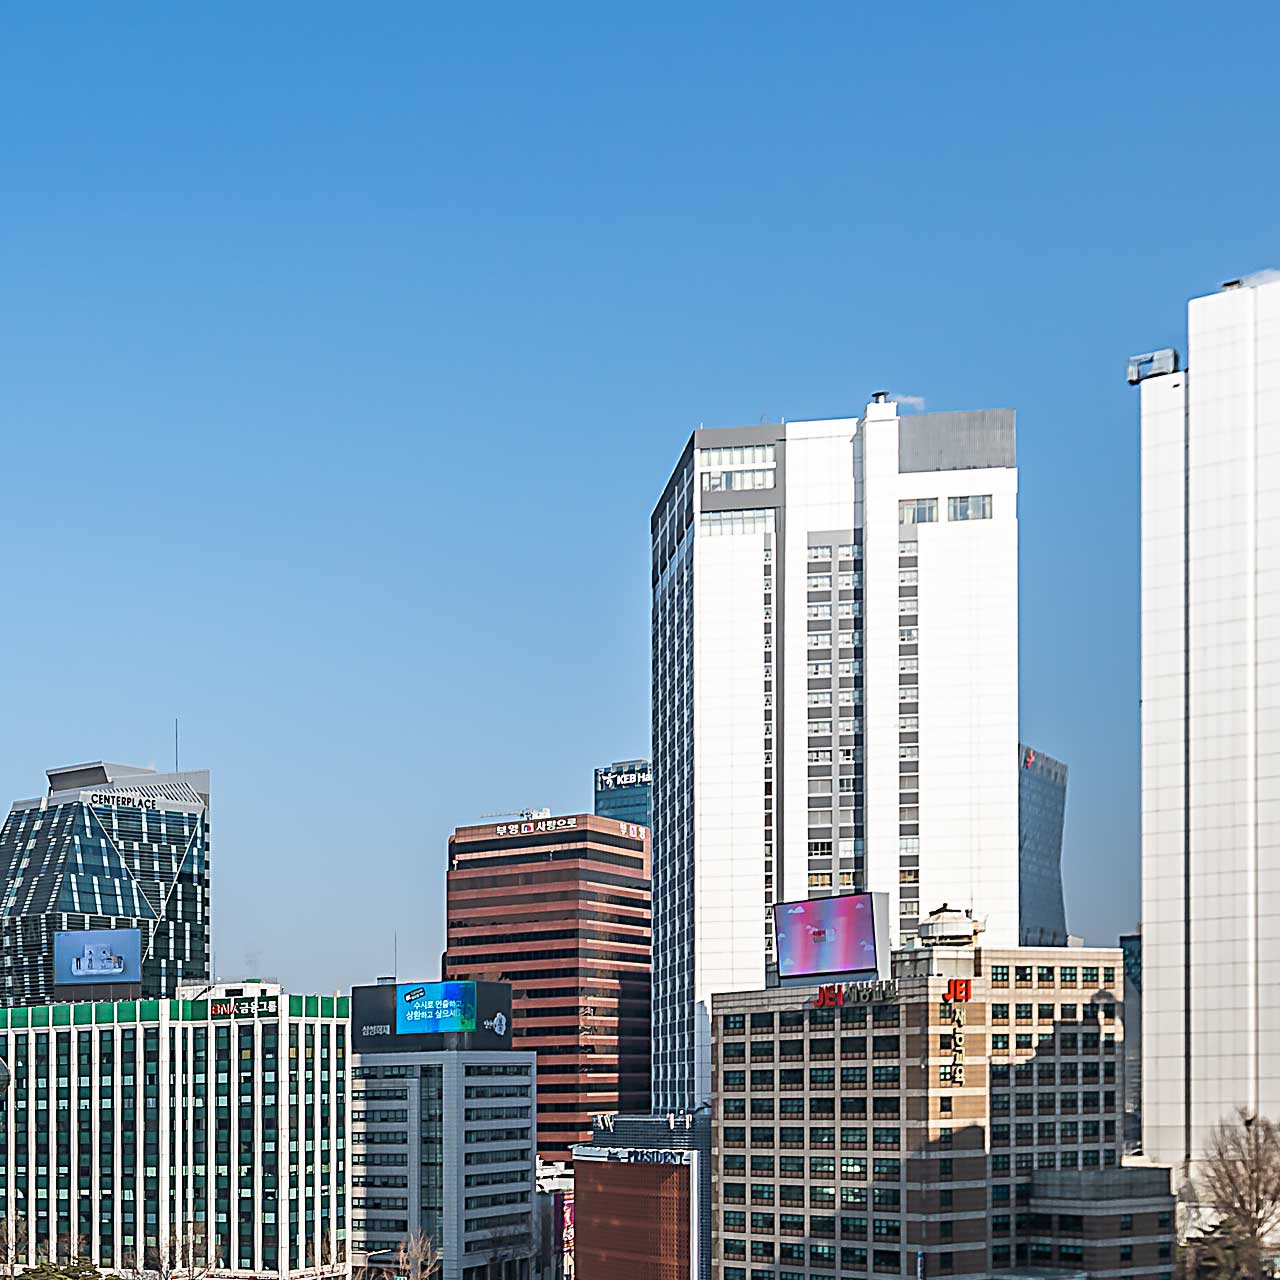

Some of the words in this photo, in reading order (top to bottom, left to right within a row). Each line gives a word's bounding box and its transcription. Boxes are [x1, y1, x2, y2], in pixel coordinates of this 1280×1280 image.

[617, 773, 637, 785] KEB
[637, 772, 652, 784] Ha
[91, 793, 156, 810] CENTERPLACE
[496, 824, 519, 836] 부영
[535, 817, 578, 832] 사랑으로
[812, 984, 844, 1008] JEI
[942, 978, 972, 1002] JEI
[414, 1001, 434, 1011] 수시로
[361, 1024, 391, 1036] 삼성화재
[628, 1150, 685, 1164] PRESIDENT
